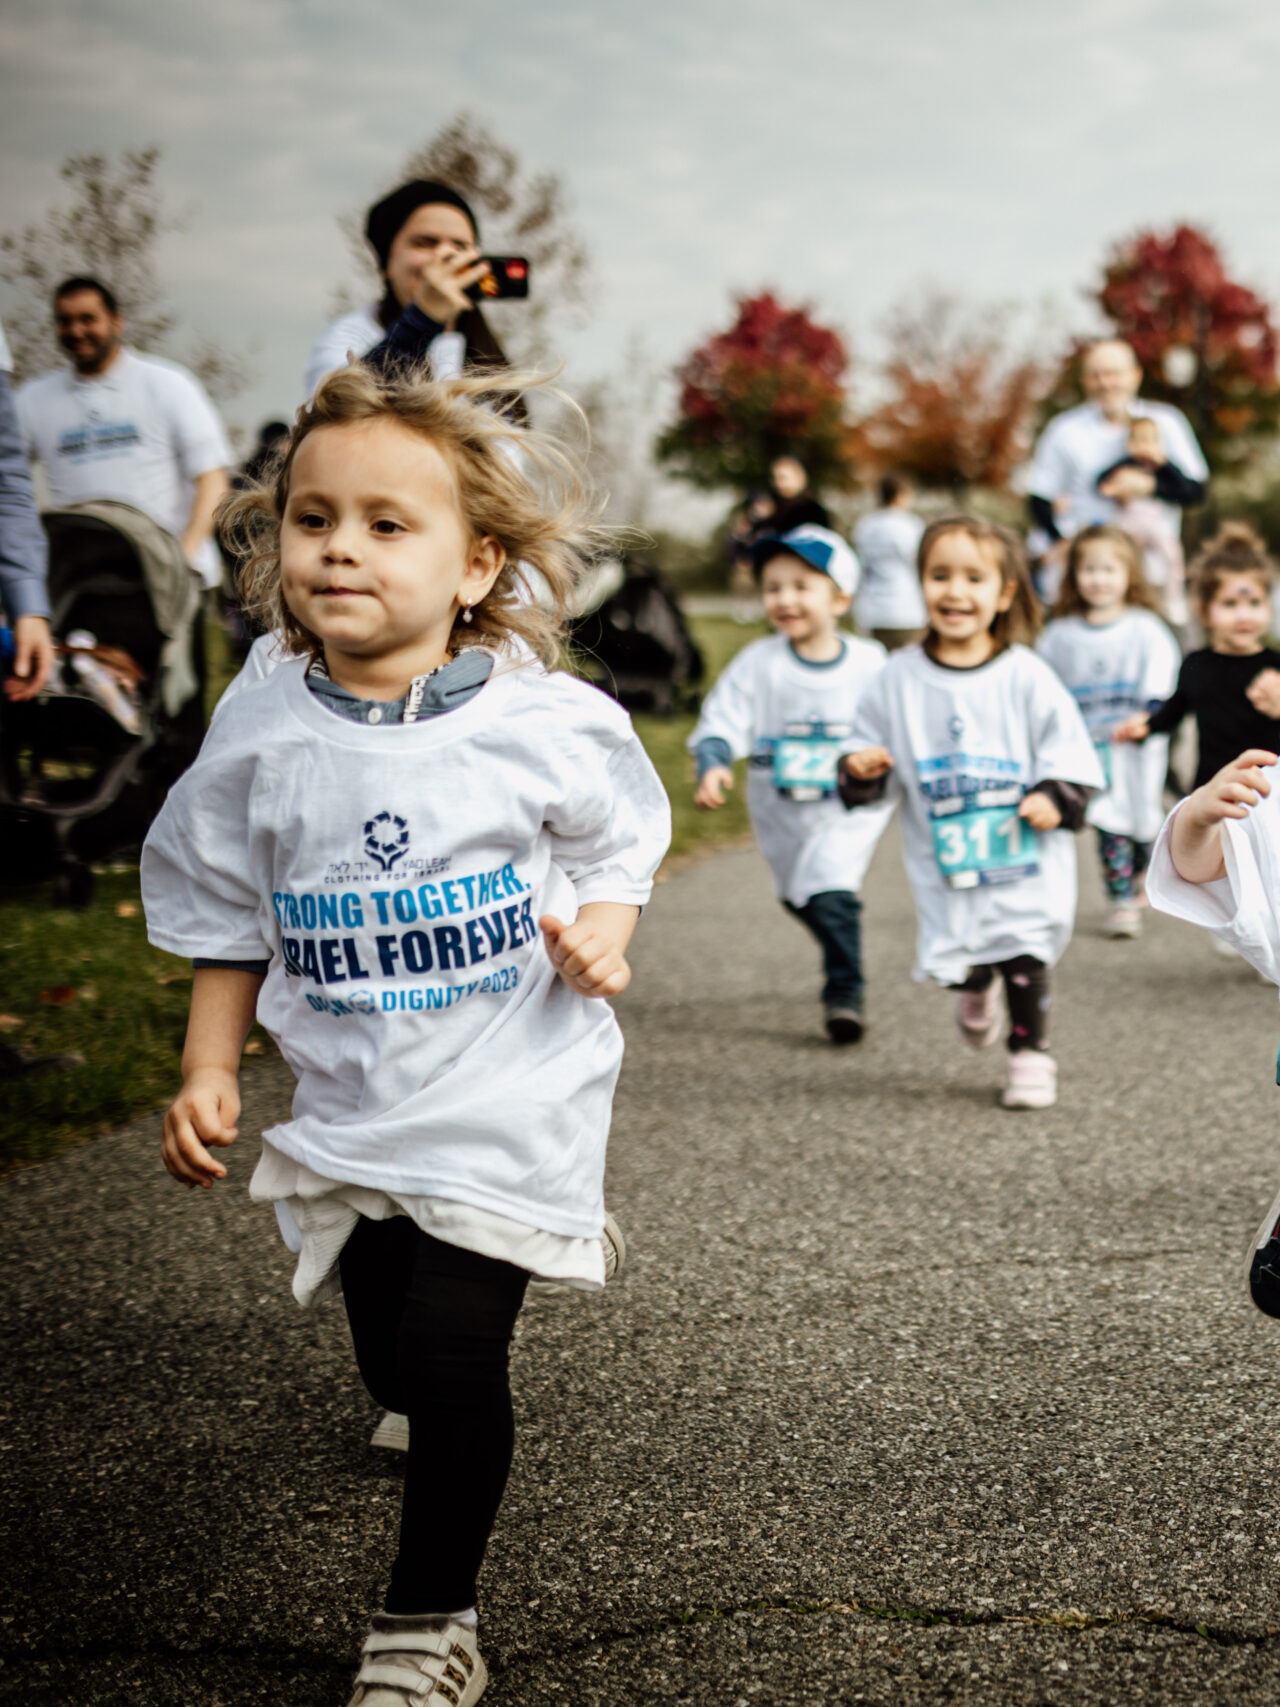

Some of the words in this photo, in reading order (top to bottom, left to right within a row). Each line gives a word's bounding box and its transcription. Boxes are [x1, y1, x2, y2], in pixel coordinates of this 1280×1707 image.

[937, 814, 1022, 866] 311
[324, 873, 380, 884] CLOTHING
[272, 890, 365, 930] STRONG
[282, 935, 370, 985] RAEL
[375, 896, 536, 978] FOREVER
[381, 980, 479, 1012] DIGNITY
[479, 965, 518, 993] 2023
